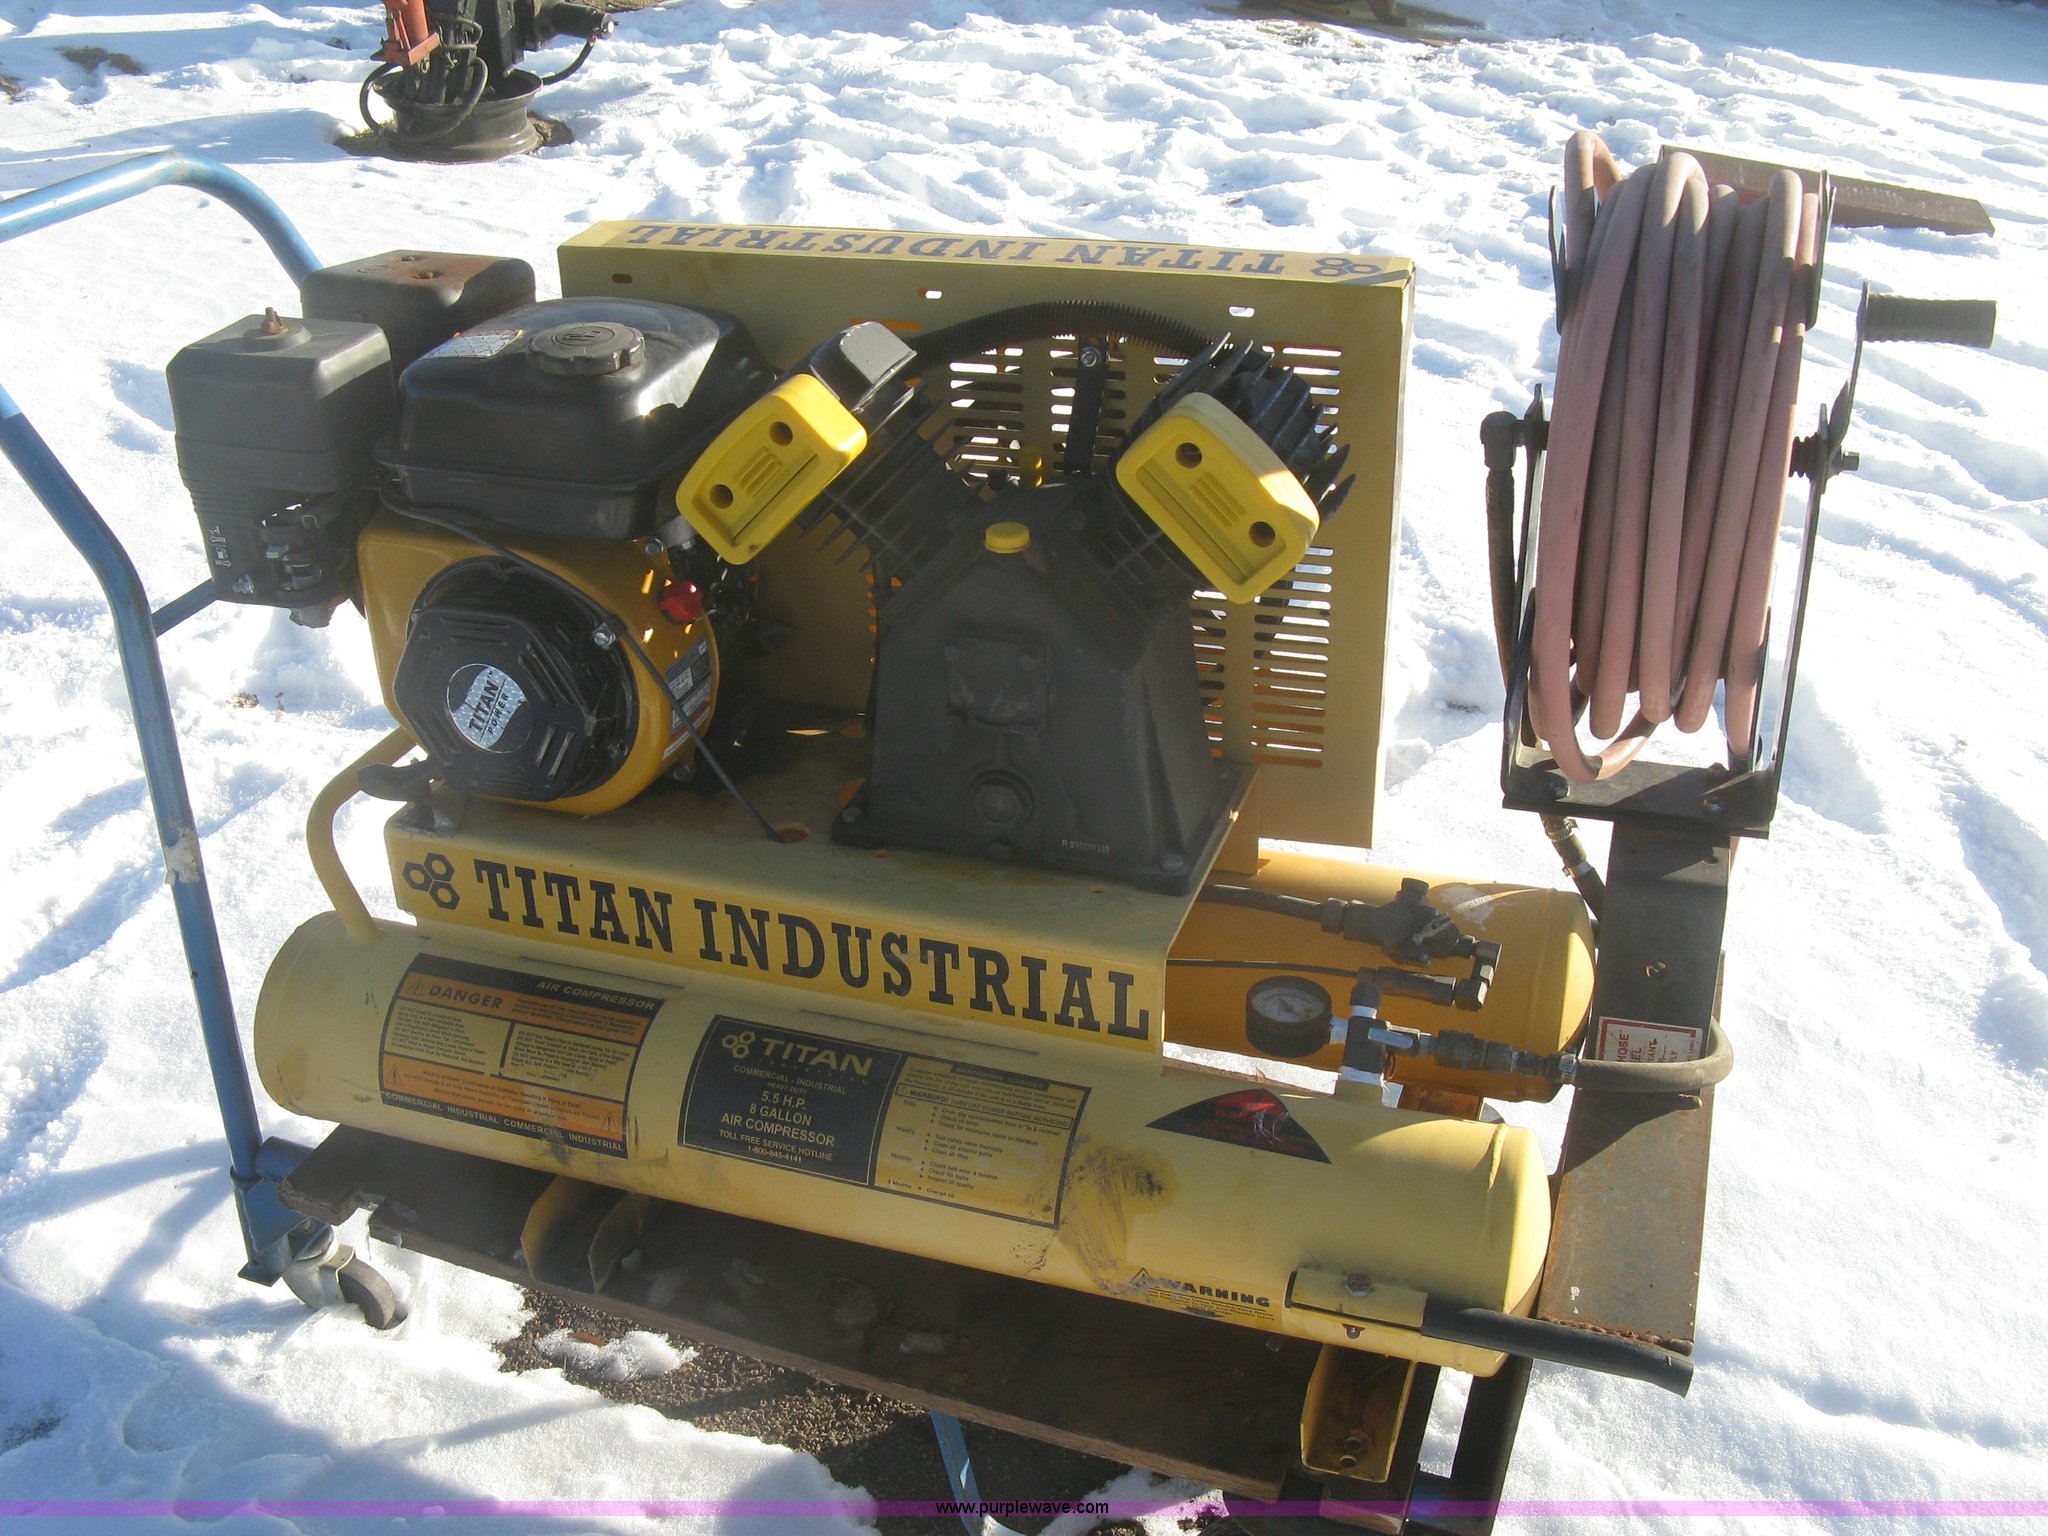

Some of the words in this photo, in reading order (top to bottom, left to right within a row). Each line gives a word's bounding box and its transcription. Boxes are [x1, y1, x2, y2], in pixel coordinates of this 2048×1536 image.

[627, 224, 1048, 262] INDUSTRIAL
[1055, 244, 1285, 274] TITAN
[468, 679, 501, 731] TITAN
[487, 692, 510, 734] POWER
[474, 858, 673, 953] TITAN
[693, 898, 1149, 1041] INDUSTRIAL
[428, 984, 504, 1009] DANGER
[536, 981, 561, 993] AIR
[563, 985, 656, 1010] COMPRESSOR
[762, 1036, 874, 1076] TITAN
[733, 1064, 790, 1083] COMMERCIAL
[796, 1077, 847, 1096] INDUSTRIAL
[749, 1103, 756, 1115] 8
[760, 1106, 812, 1127] GALLON
[761, 1090, 780, 1105] 5.5
[783, 1095, 806, 1110] H.P.
[385, 1091, 444, 1112] COMMERCIAL
[447, 1106, 500, 1125] INDUSTRIAL
[503, 1118, 565, 1139] COMMERCIAL
[568, 1132, 625, 1153] INDUSTRIAL
[720, 1112, 743, 1127] AIR
[745, 1117, 836, 1147] COMPRESSOR
[719, 1129, 739, 1142] TOLL
[740, 1134, 762, 1146] FREE
[763, 1138, 797, 1154] SERVICE
[798, 1147, 834, 1161] HOTLINE
[1159, 1277, 1271, 1308] WARNING
